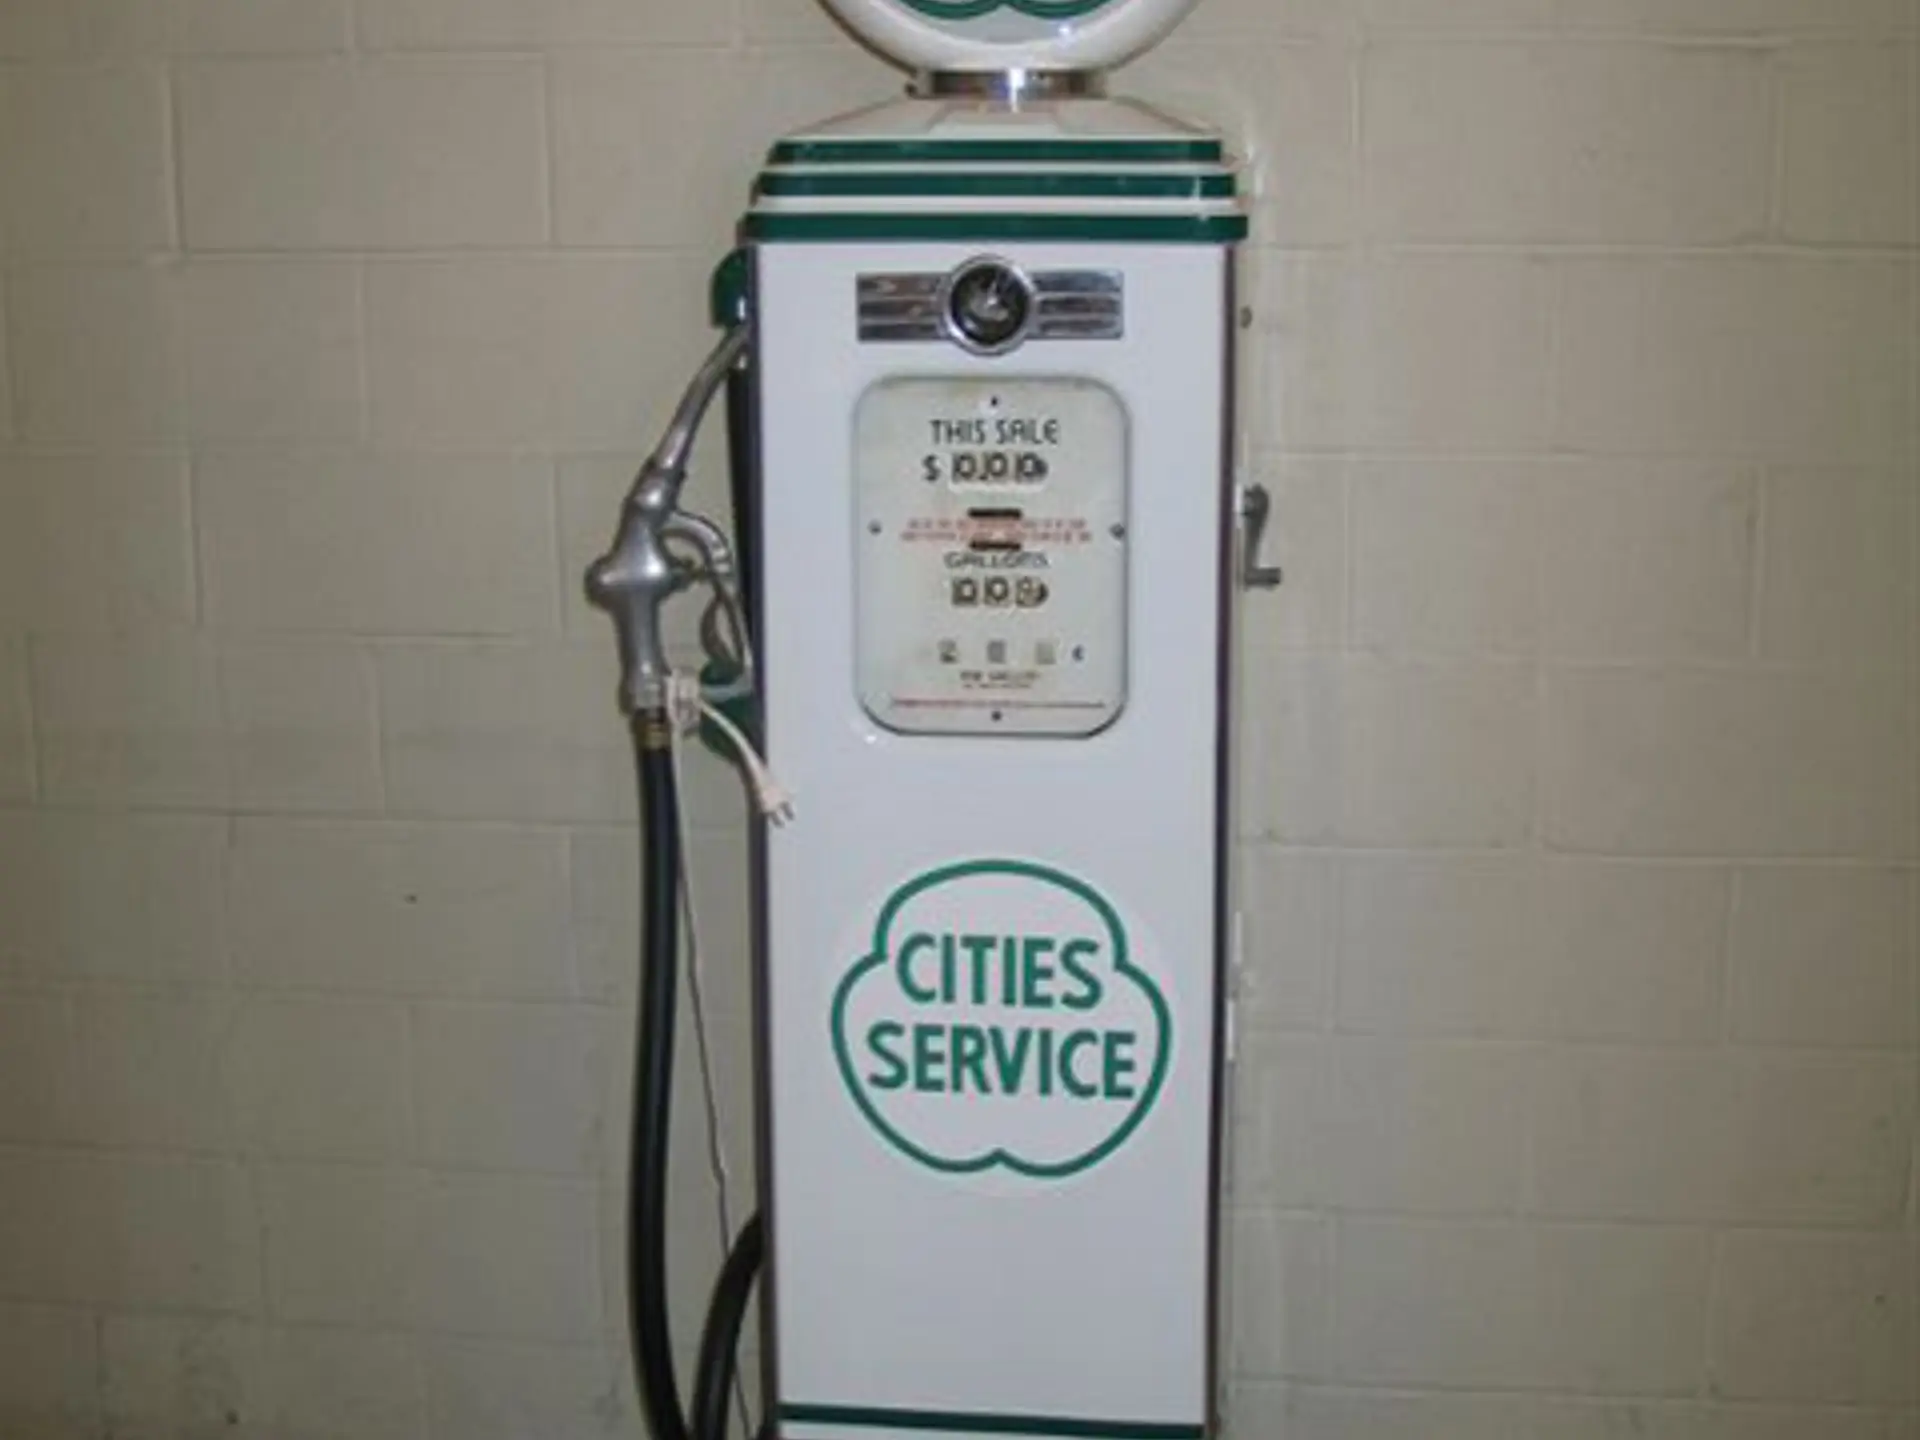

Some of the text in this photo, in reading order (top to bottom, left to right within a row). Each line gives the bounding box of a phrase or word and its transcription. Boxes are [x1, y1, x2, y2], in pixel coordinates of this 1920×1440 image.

[930, 418, 987, 444] THIS
[896, 933, 1103, 1010] CITIES
[866, 1020, 1137, 1099] SERVICE
